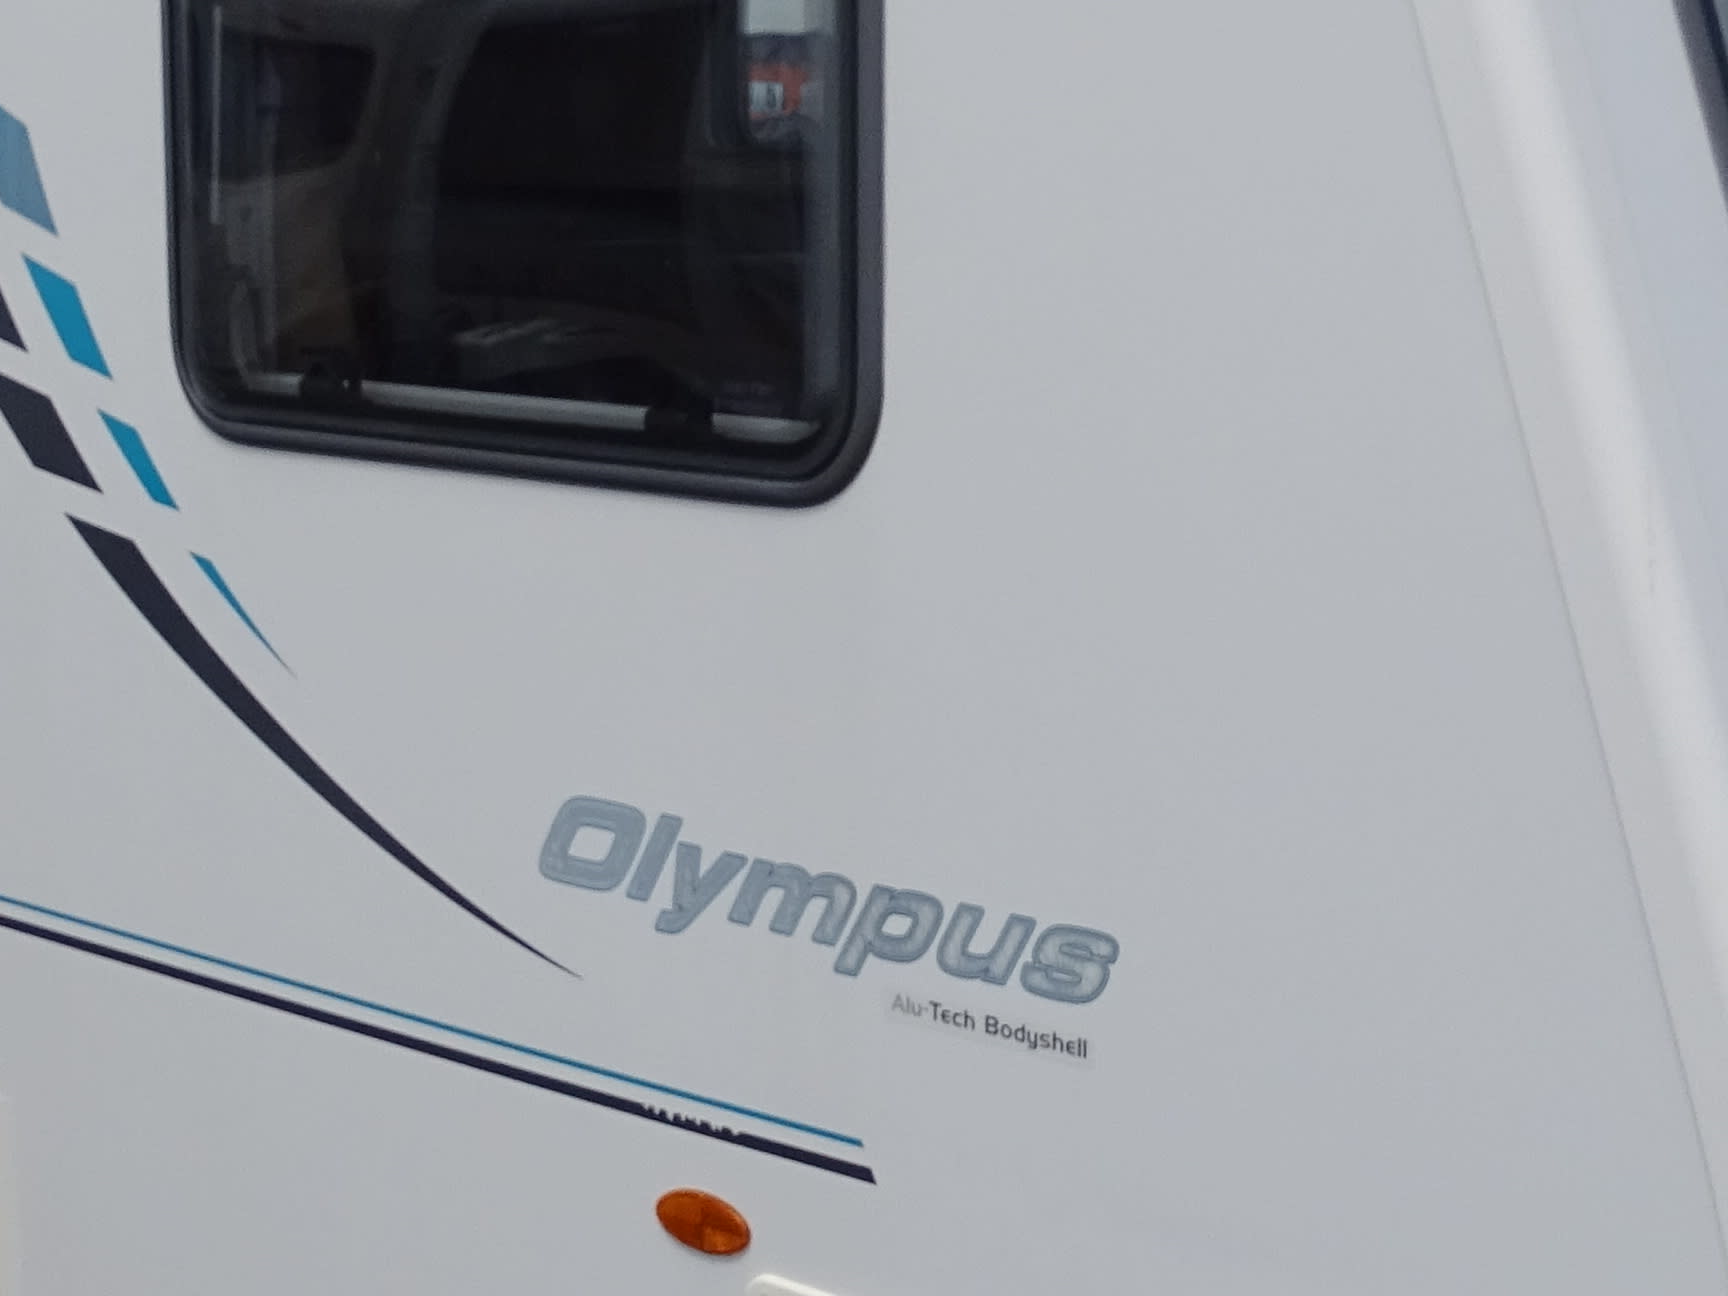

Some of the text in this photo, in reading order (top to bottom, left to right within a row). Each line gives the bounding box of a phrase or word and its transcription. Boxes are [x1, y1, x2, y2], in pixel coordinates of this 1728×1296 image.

[538, 795, 1121, 1004] Olympus
[891, 993, 1088, 1059] Alu-Tech Bodyshell
